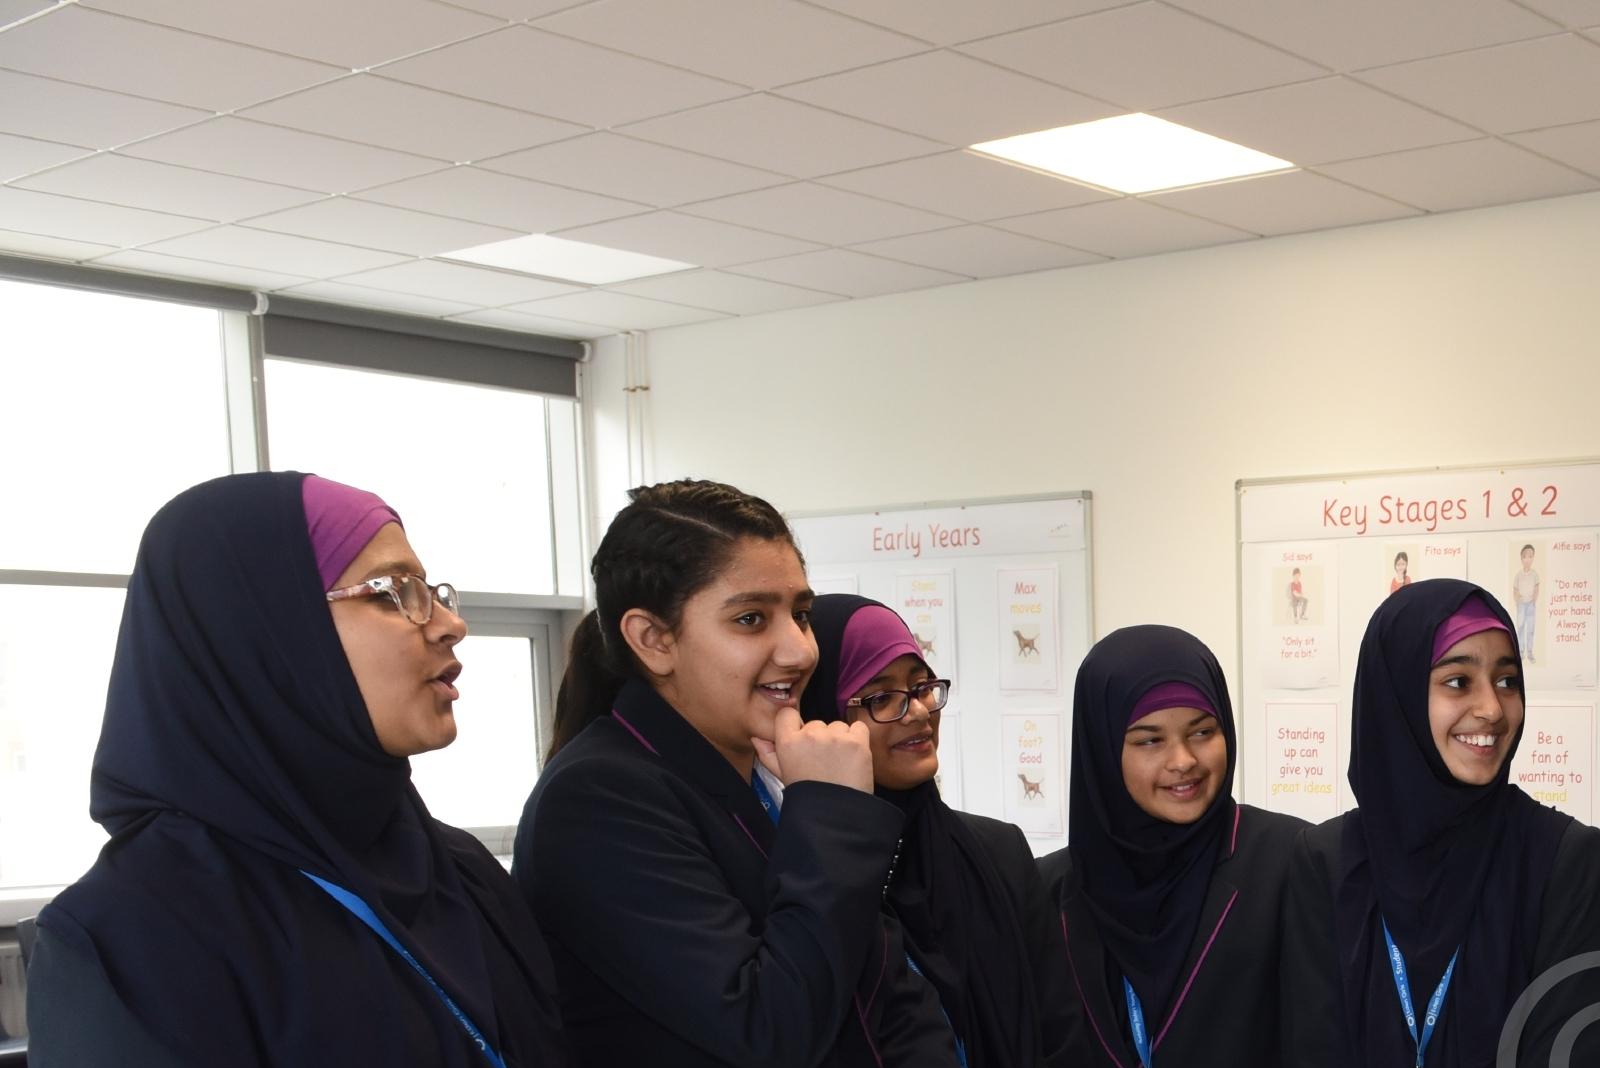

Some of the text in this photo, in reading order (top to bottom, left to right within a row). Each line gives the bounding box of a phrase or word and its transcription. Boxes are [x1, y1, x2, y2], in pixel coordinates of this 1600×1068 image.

[1322, 485, 1558, 535] Key Stages 1 & 2
[873, 523, 981, 558] Early Years
[1552, 542, 1591, 552] Alfie says
[1443, 546, 1462, 557] says
[1014, 581, 1037, 595] Max
[1573, 580, 1588, 589] not
[1550, 593, 1593, 605] just raise
[1010, 602, 1042, 615] moves
[1548, 607, 1568, 618] your
[1556, 620, 1586, 633] Always
[1278, 727, 1326, 744] Standing
[1537, 731, 1564, 744] Be a
[1019, 751, 1043, 764] Good
[1284, 747, 1318, 760] up can
[1531, 750, 1569, 765] fan of
[1280, 763, 1323, 778] give you
[1518, 770, 1583, 787] wanting to
[1272, 780, 1333, 796] great ideas
[1534, 788, 1569, 802] stand
